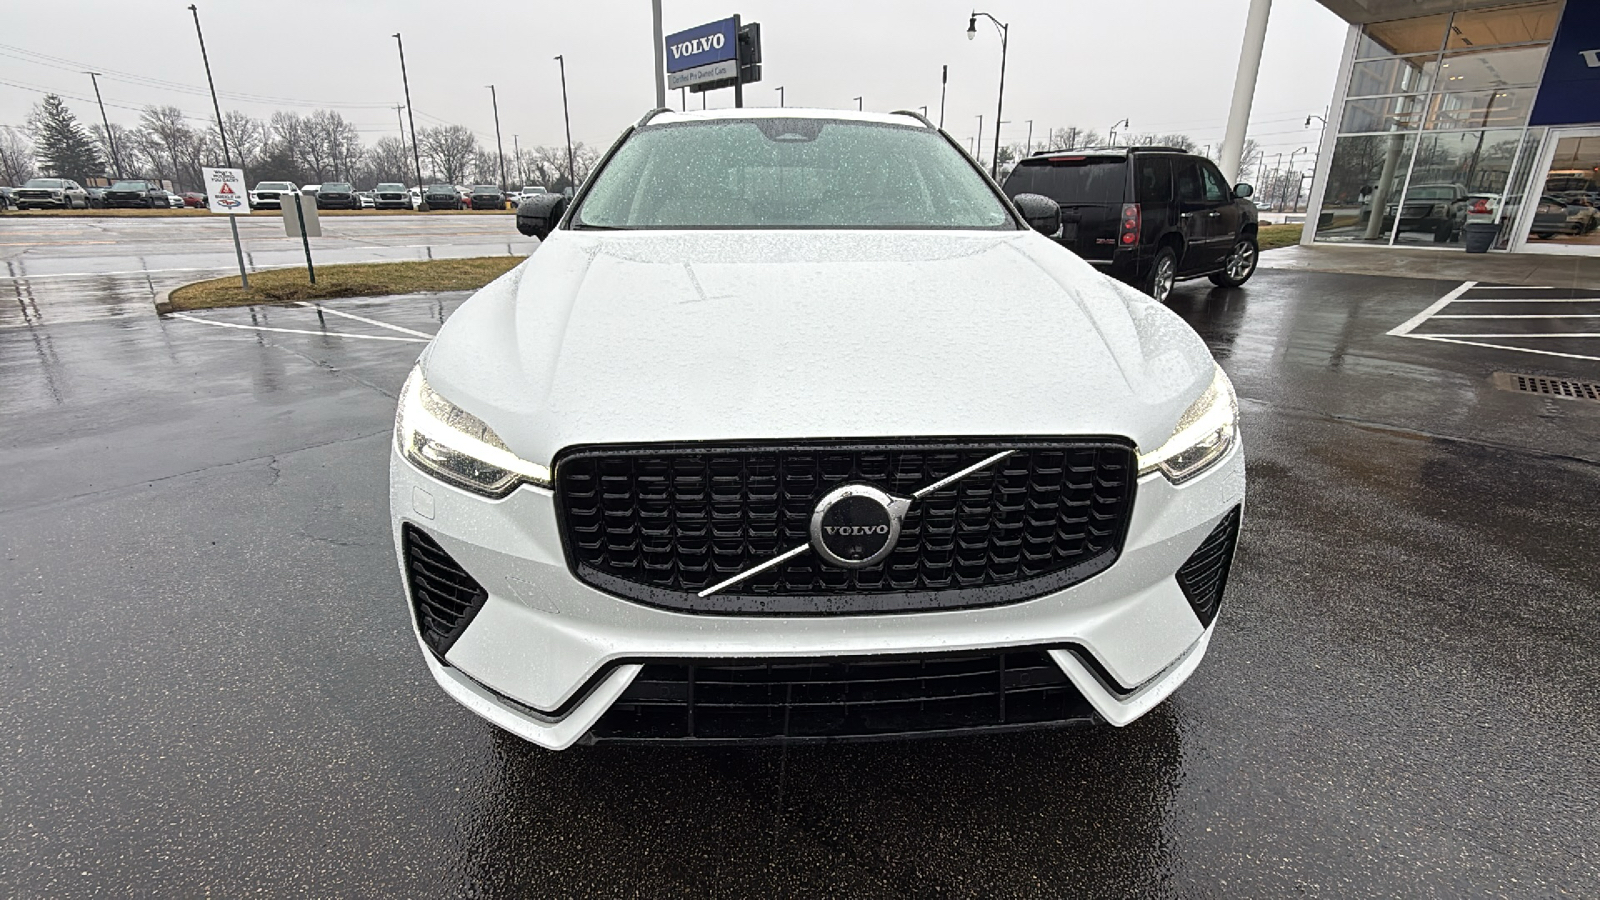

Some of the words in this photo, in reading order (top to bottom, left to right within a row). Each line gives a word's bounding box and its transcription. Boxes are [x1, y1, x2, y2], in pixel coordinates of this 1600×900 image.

[670, 33, 725, 59] VOLVO
[715, 67, 726, 75] Cars
[824, 524, 888, 536] VOLVO
